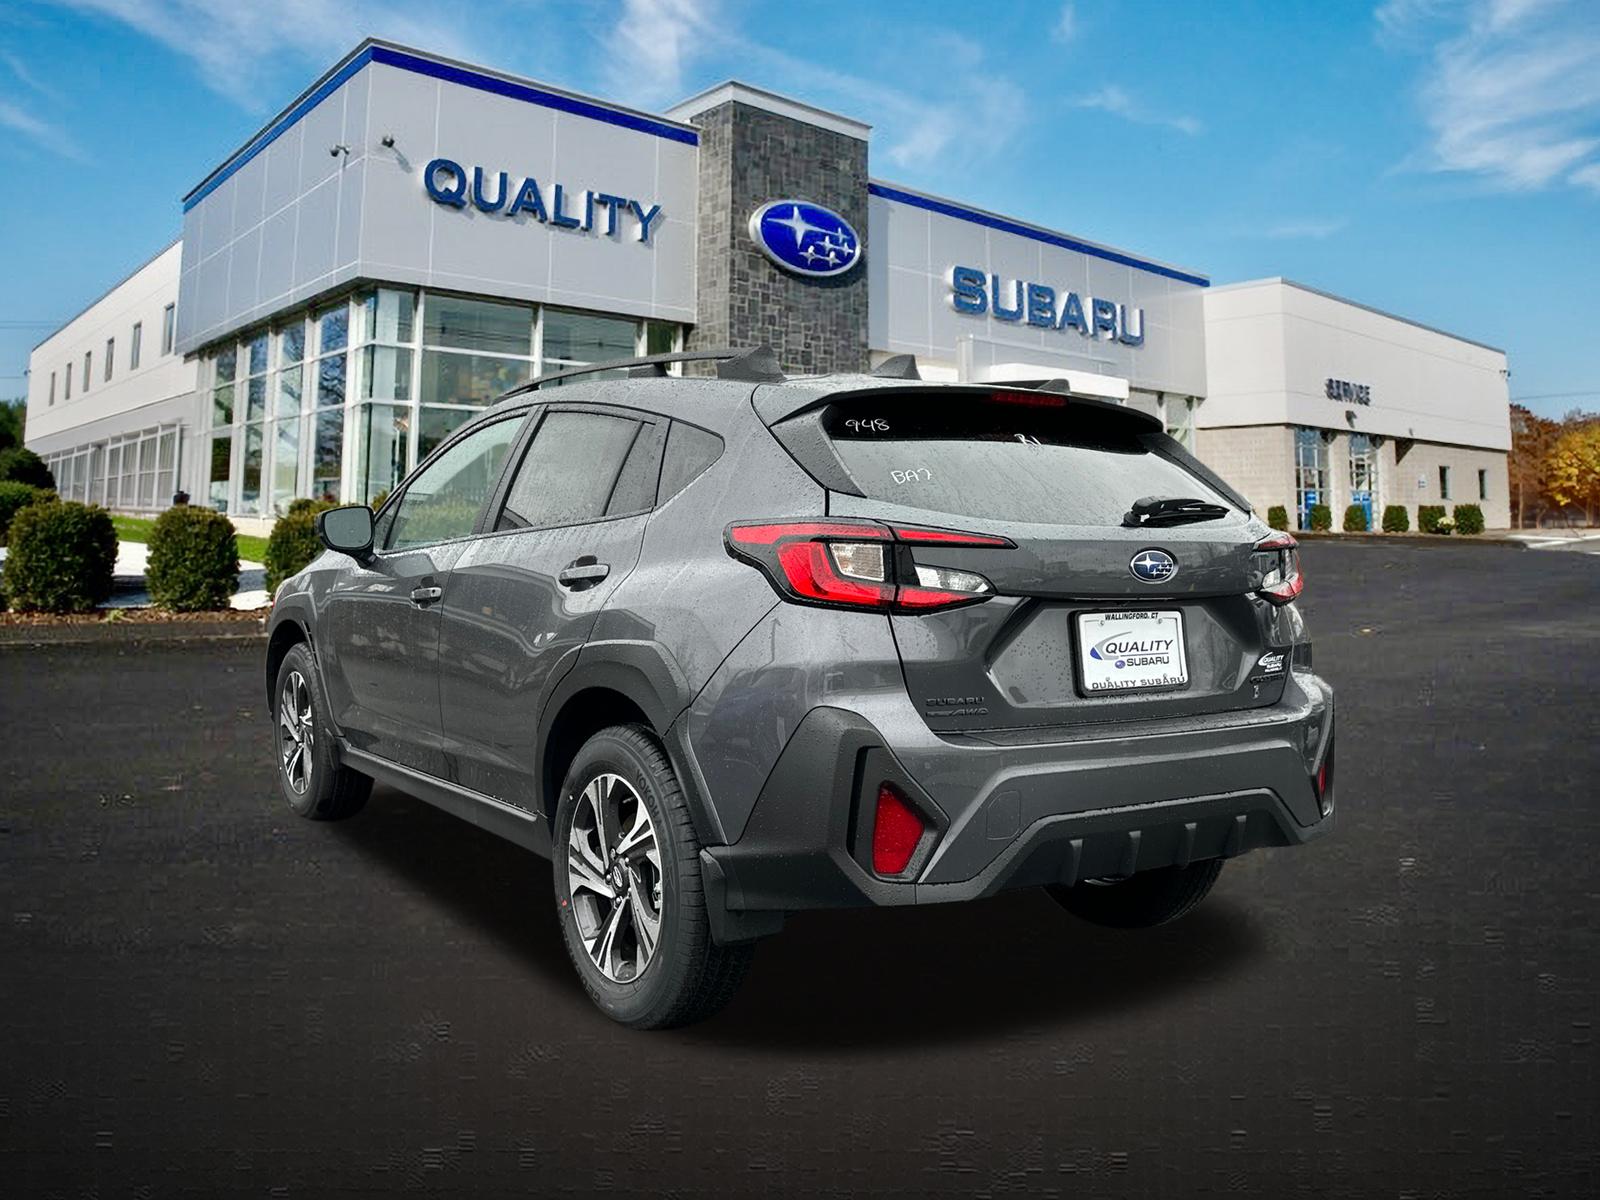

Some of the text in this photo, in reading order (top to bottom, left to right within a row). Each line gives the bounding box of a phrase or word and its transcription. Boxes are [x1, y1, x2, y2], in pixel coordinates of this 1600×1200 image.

[424, 158, 661, 242] QUALITY
[950, 265, 1145, 346] SUBARU
[1325, 378, 1371, 406] SERVICE
[845, 418, 890, 432] 948
[1105, 639, 1174, 654] QUALITY
[1126, 656, 1169, 667] SUBARU
[1091, 676, 1185, 690] QUALITY SUBARU
[926, 697, 985, 706] SUBARU
